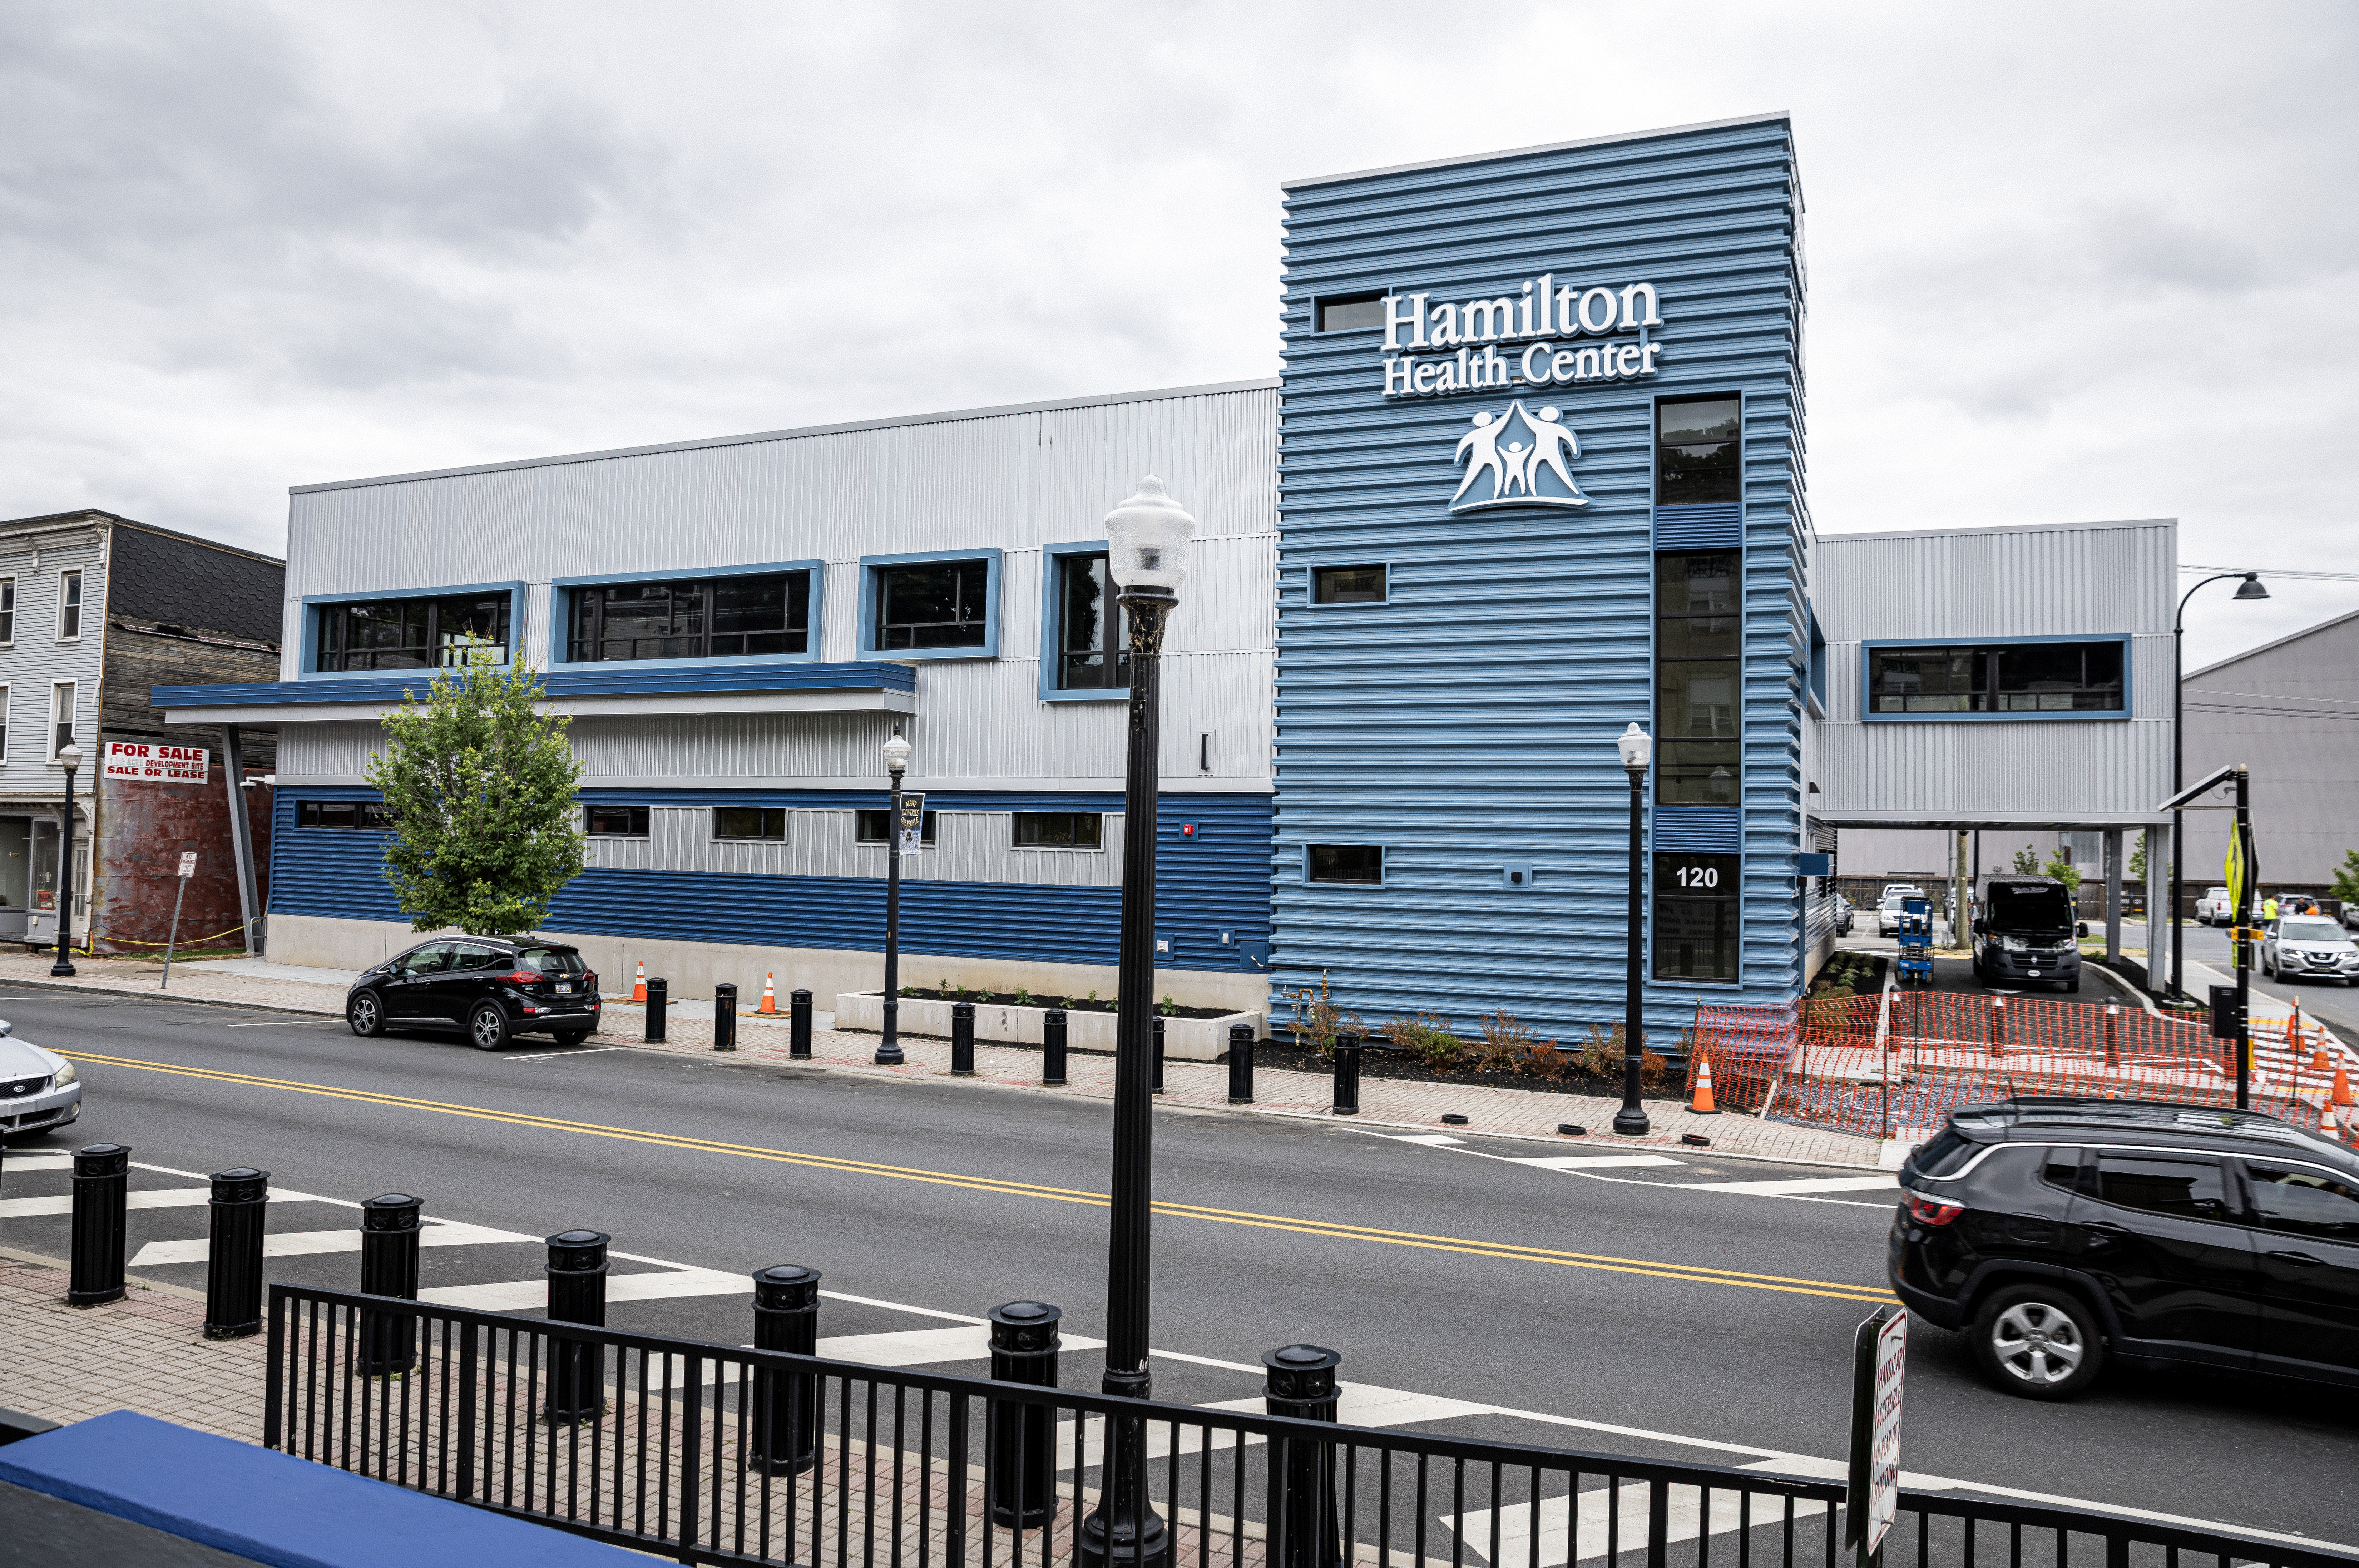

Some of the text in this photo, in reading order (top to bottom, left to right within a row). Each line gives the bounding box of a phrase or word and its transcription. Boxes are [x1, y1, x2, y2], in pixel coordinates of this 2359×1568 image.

[1381, 273, 1661, 351] Hamilton
[1382, 342, 1661, 396] Health Center
[112, 743, 203, 761] FOR SALE
[146, 760, 189, 769] DEVELOPMENT
[107, 766, 139, 775] SALE
[168, 770, 204, 779] LEASE
[905, 800, 918, 808] MANY
[906, 817, 919, 827] PEOPLE
[1677, 867, 1718, 887] 120
[1879, 1347, 1903, 1392] HANDICAP
[1876, 1383, 1901, 1430] ACCESSIBLE
[1876, 1421, 1898, 1468] IN REAR OF
[1874, 1456, 1896, 1507] BUILDING
